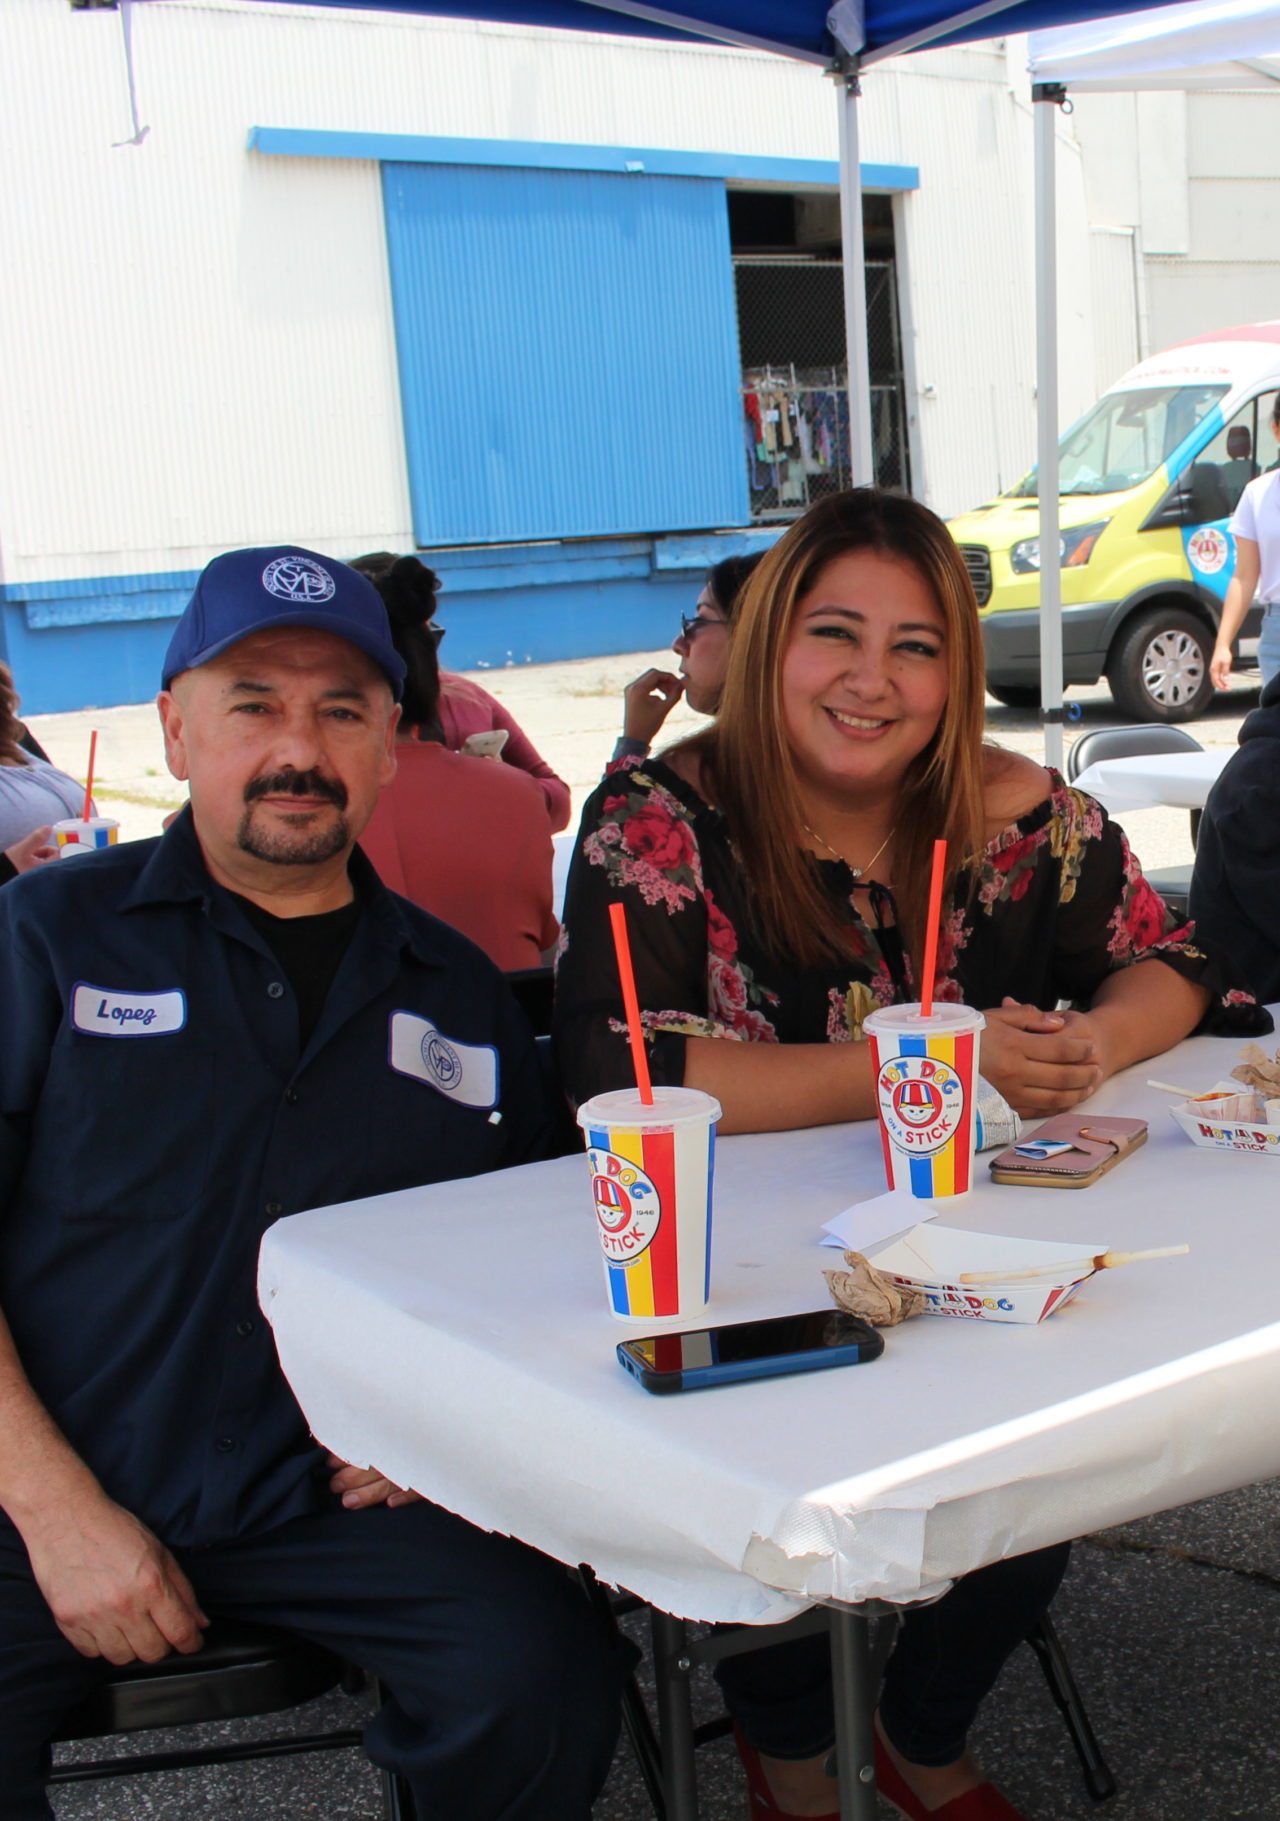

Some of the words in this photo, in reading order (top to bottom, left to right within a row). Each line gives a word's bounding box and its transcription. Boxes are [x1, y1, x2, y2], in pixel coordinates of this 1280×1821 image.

[97, 999, 157, 1026] Lopez
[880, 1061, 909, 1094] HOT
[920, 1061, 960, 1095] DOG
[905, 1118, 952, 1145] STICK
[1197, 1123, 1233, 1141] HOT
[1232, 1141, 1269, 1152] STICK
[606, 1155, 653, 1200] DOG
[603, 1225, 646, 1253] STICK
[940, 1307, 985, 1319] STICK
[964, 1294, 1015, 1312] DOG
